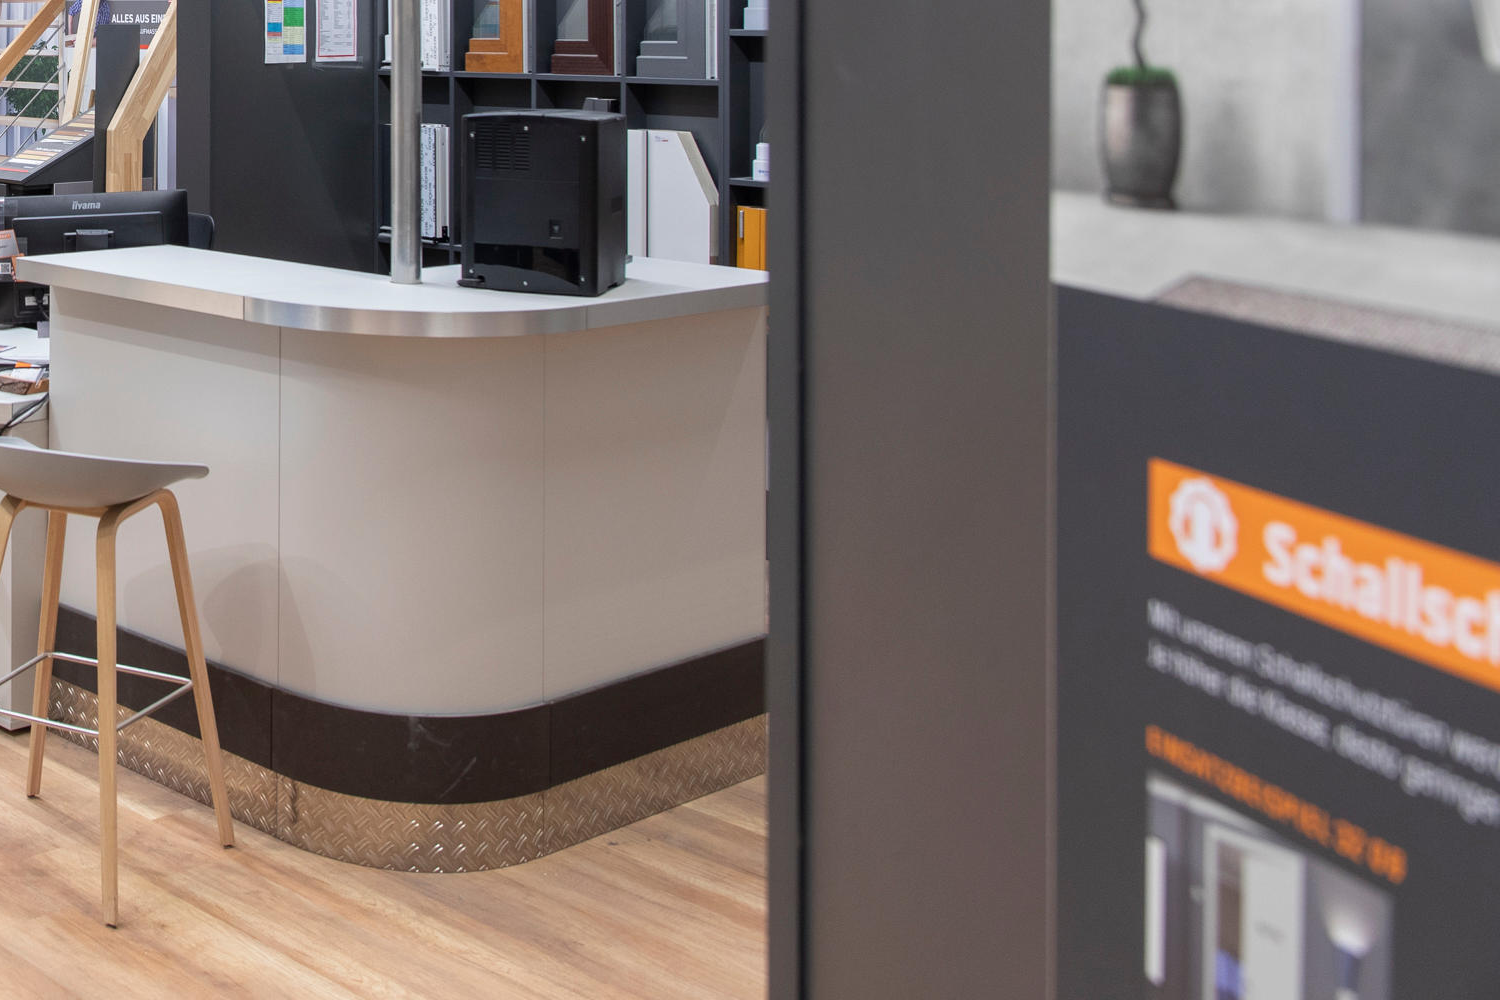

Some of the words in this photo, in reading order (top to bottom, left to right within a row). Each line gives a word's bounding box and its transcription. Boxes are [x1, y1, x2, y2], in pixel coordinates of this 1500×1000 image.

[111, 13, 134, 24] ALLES
[134, 13, 150, 24] AUS
[71, 200, 101, 211] iiyama
